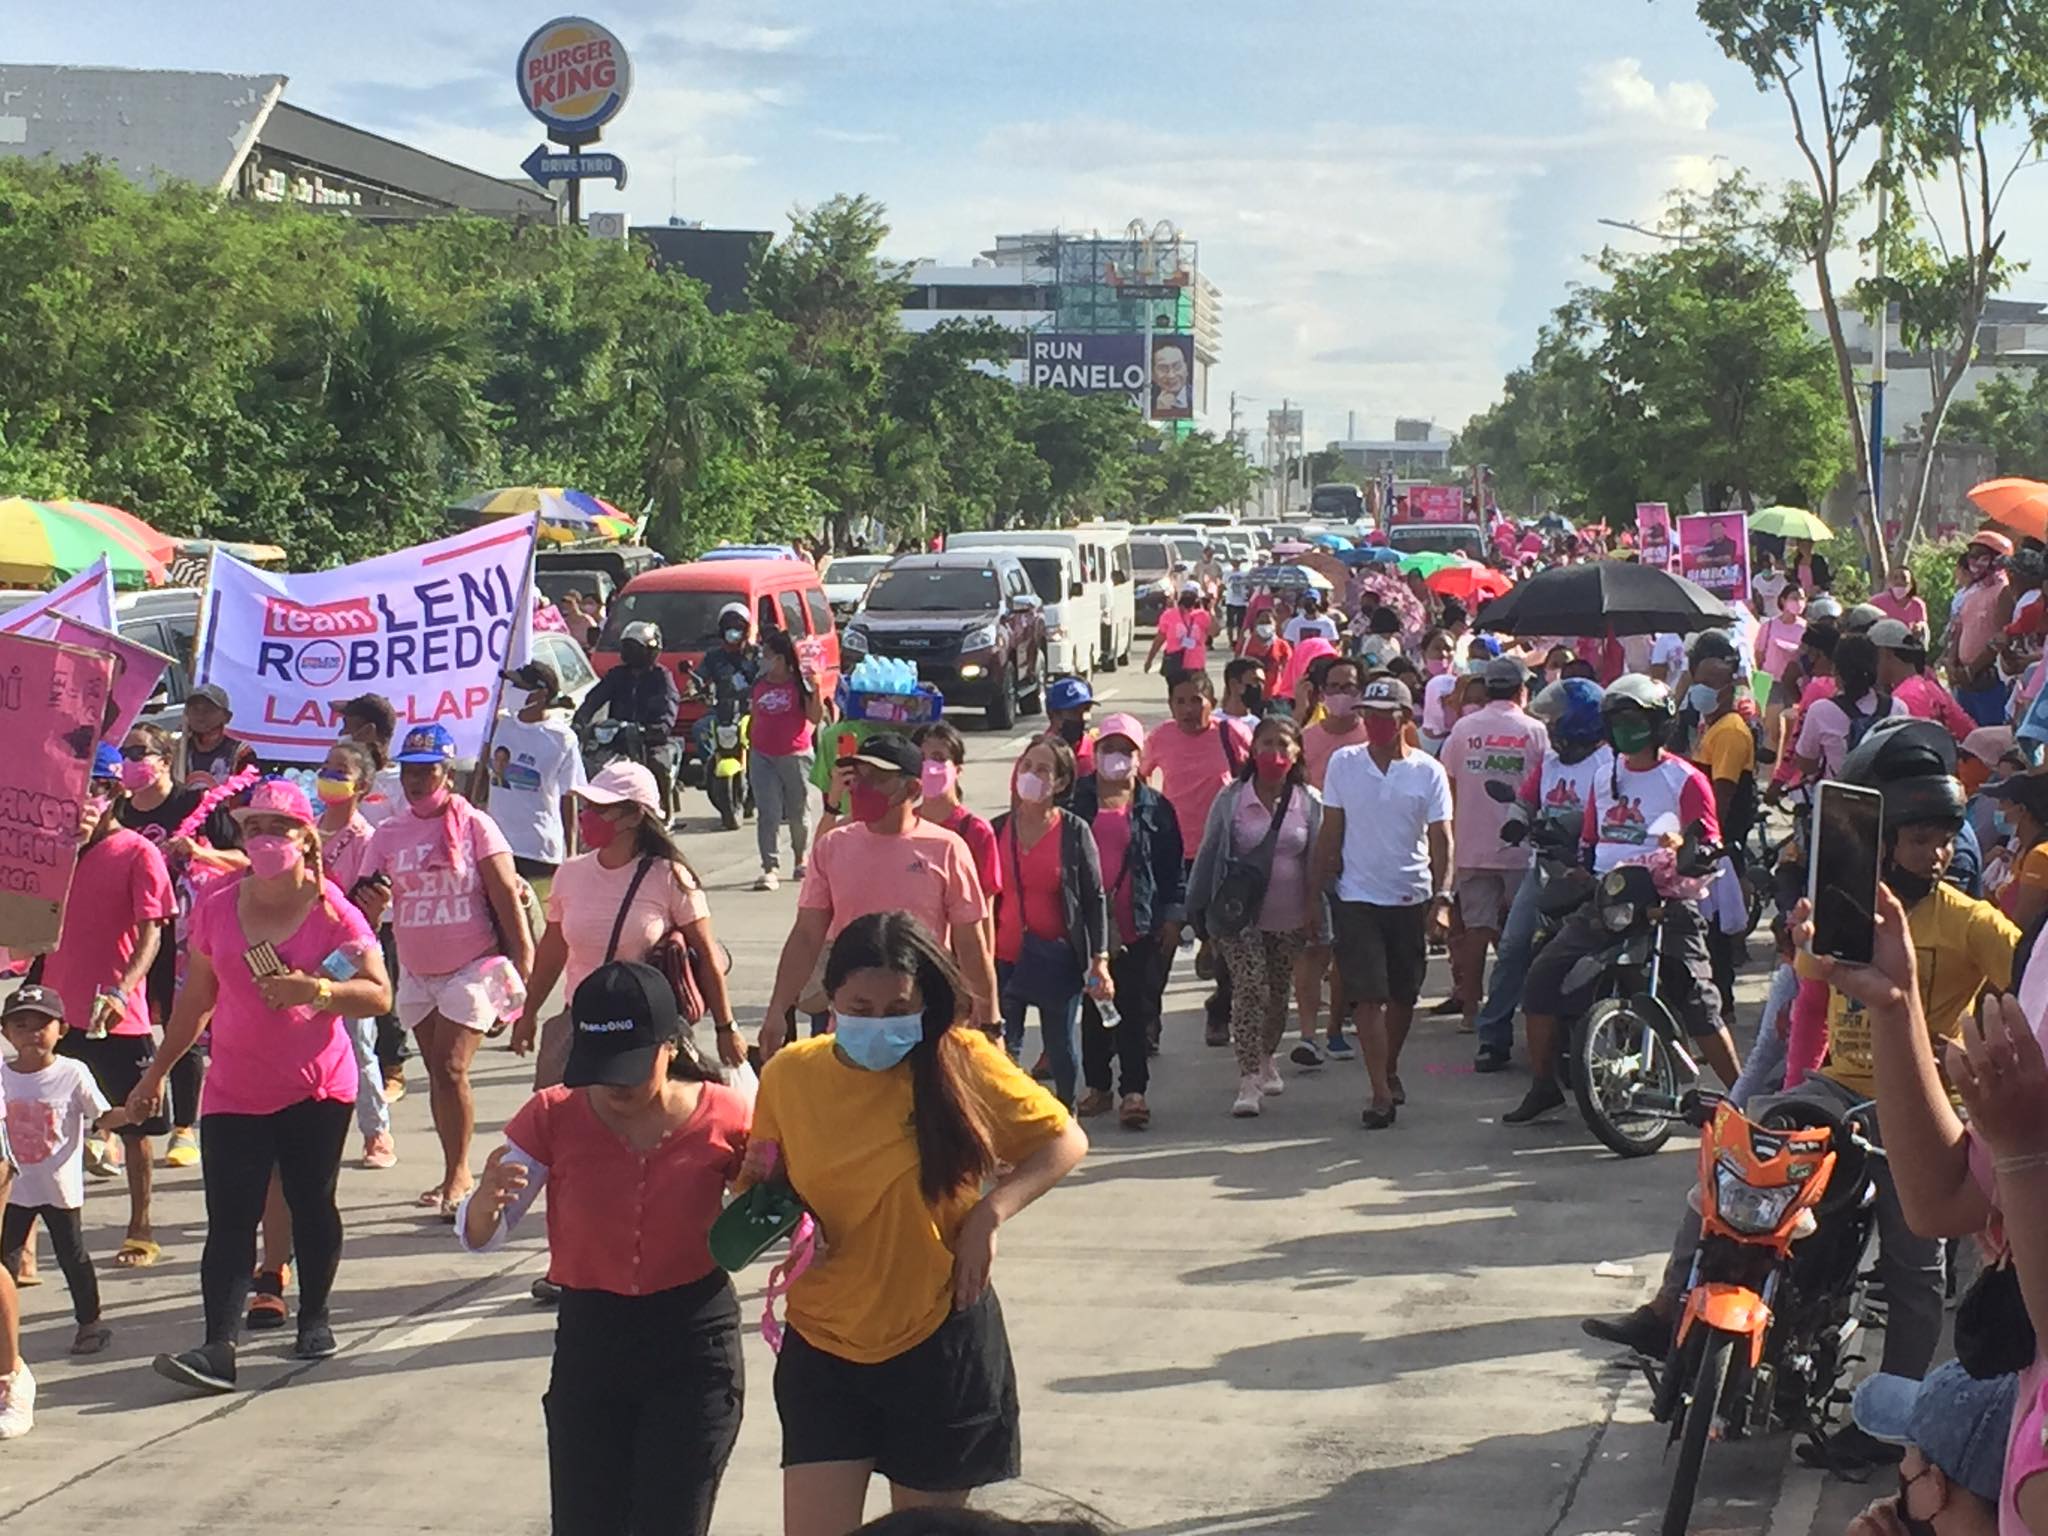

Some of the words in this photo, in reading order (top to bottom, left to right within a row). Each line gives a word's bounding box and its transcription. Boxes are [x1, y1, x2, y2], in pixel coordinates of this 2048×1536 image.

[529, 40, 613, 80] BURGER
[533, 60, 616, 109] KING
[541, 159, 578, 172] DRIVE
[1035, 342, 1082, 360] RUN
[1035, 365, 1144, 389] PANELO
[271, 604, 373, 632] team
[377, 564, 513, 633] LENI
[1468, 736, 1482, 750] 10
[397, 867, 475, 898] LENI
[398, 897, 473, 928] LEAD
